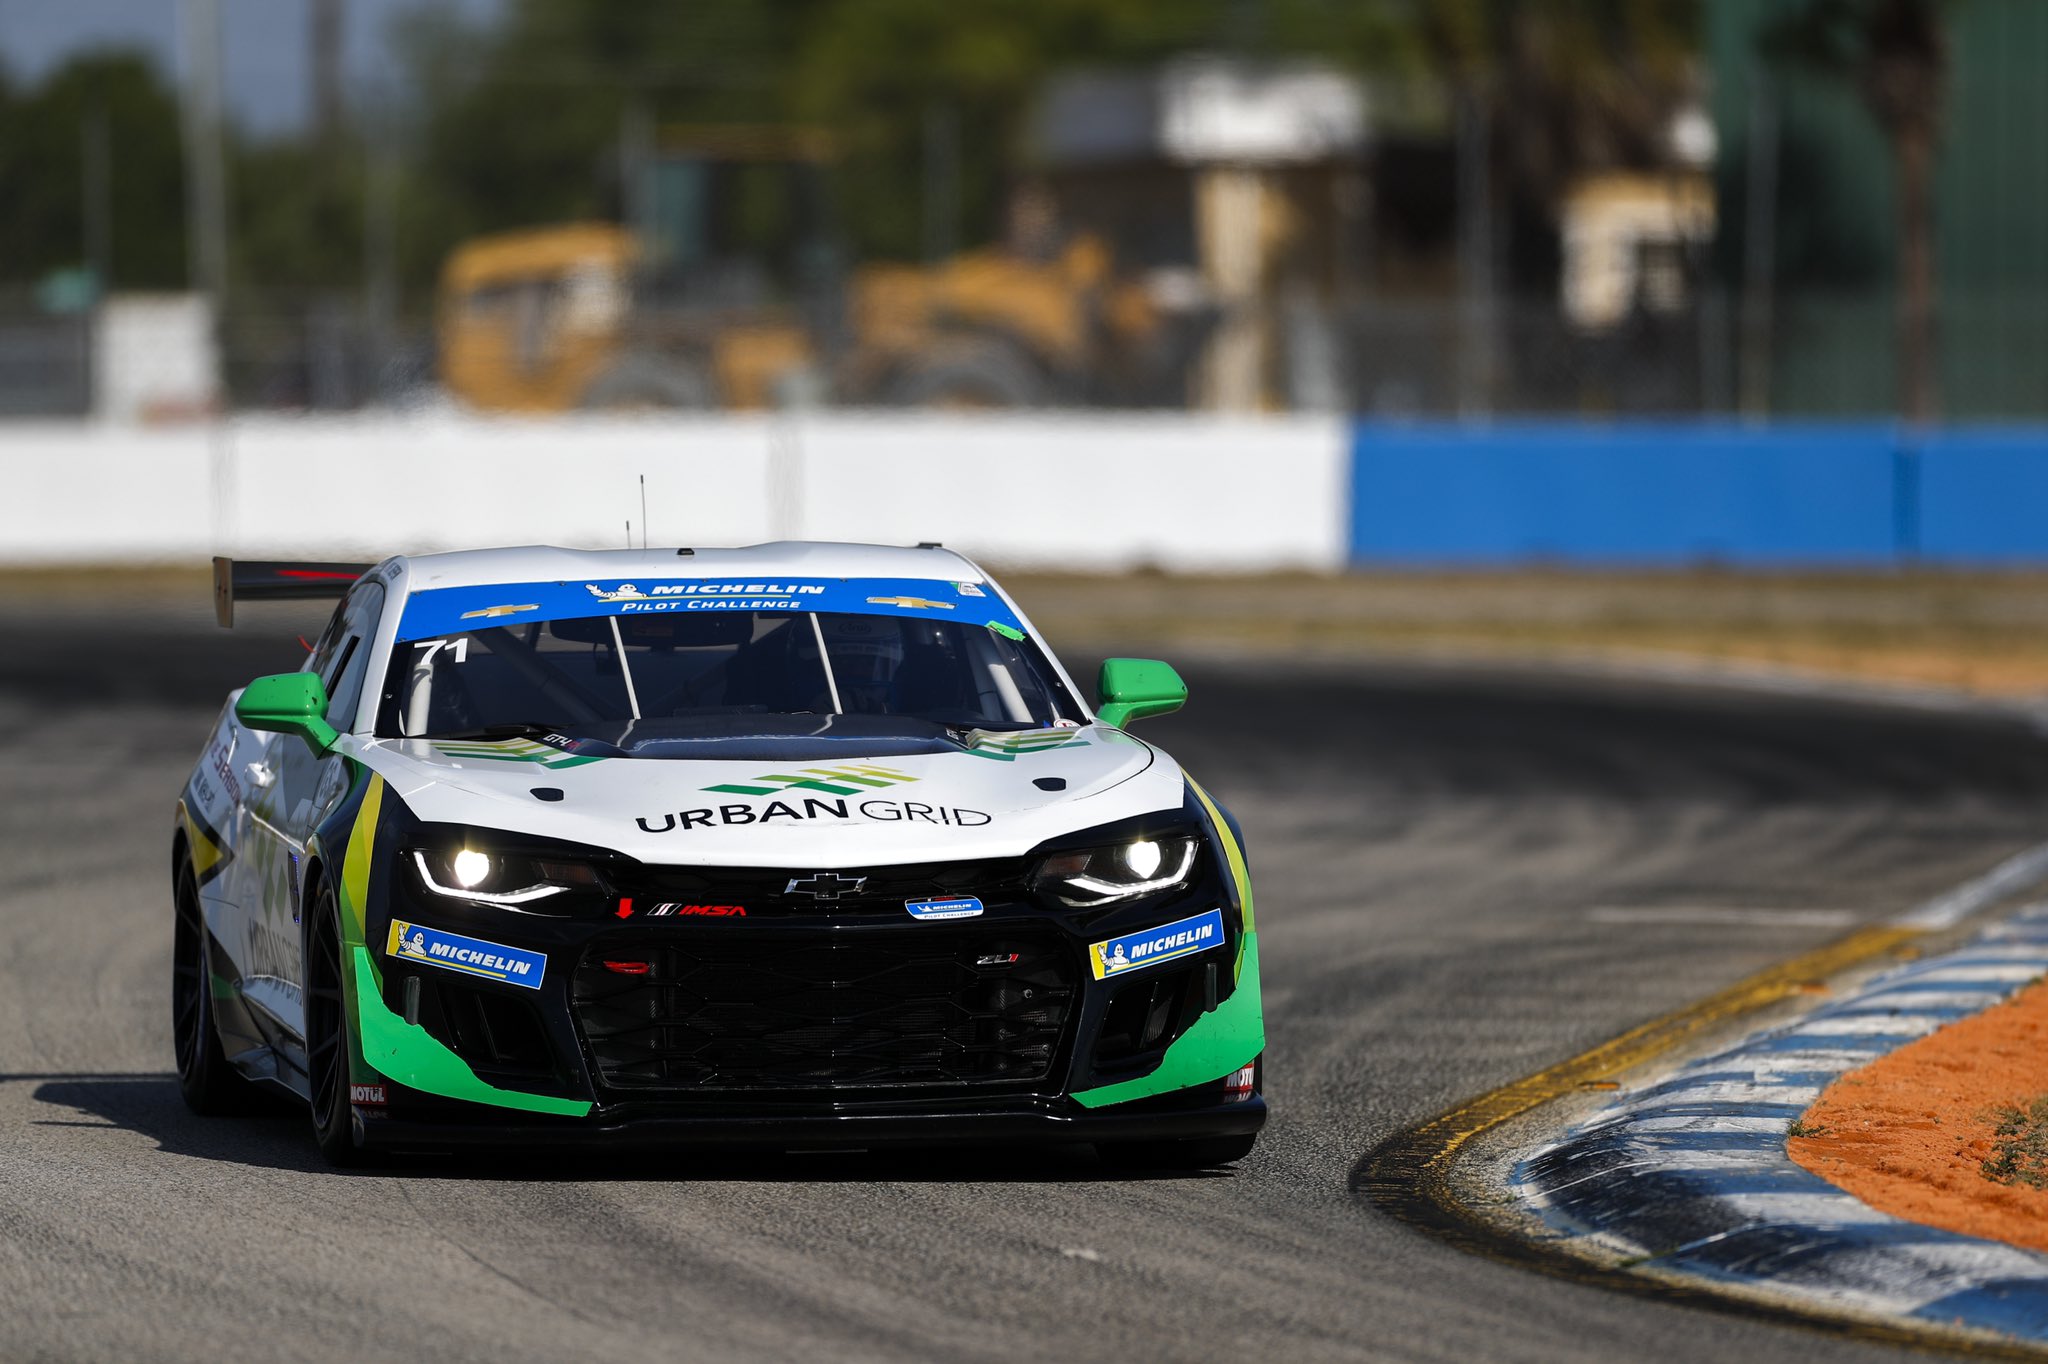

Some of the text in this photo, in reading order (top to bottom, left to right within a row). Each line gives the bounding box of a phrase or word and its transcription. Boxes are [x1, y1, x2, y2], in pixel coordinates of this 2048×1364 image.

[651, 584, 826, 596] MICHELIN
[621, 600, 801, 612] PILOT CHALLENGE
[413, 637, 469, 667] 71
[679, 905, 747, 917] IMSA
[1130, 923, 1214, 960] MICHELIN
[428, 942, 532, 977] MICHELIN
[350, 1085, 385, 1102] MOTUL
